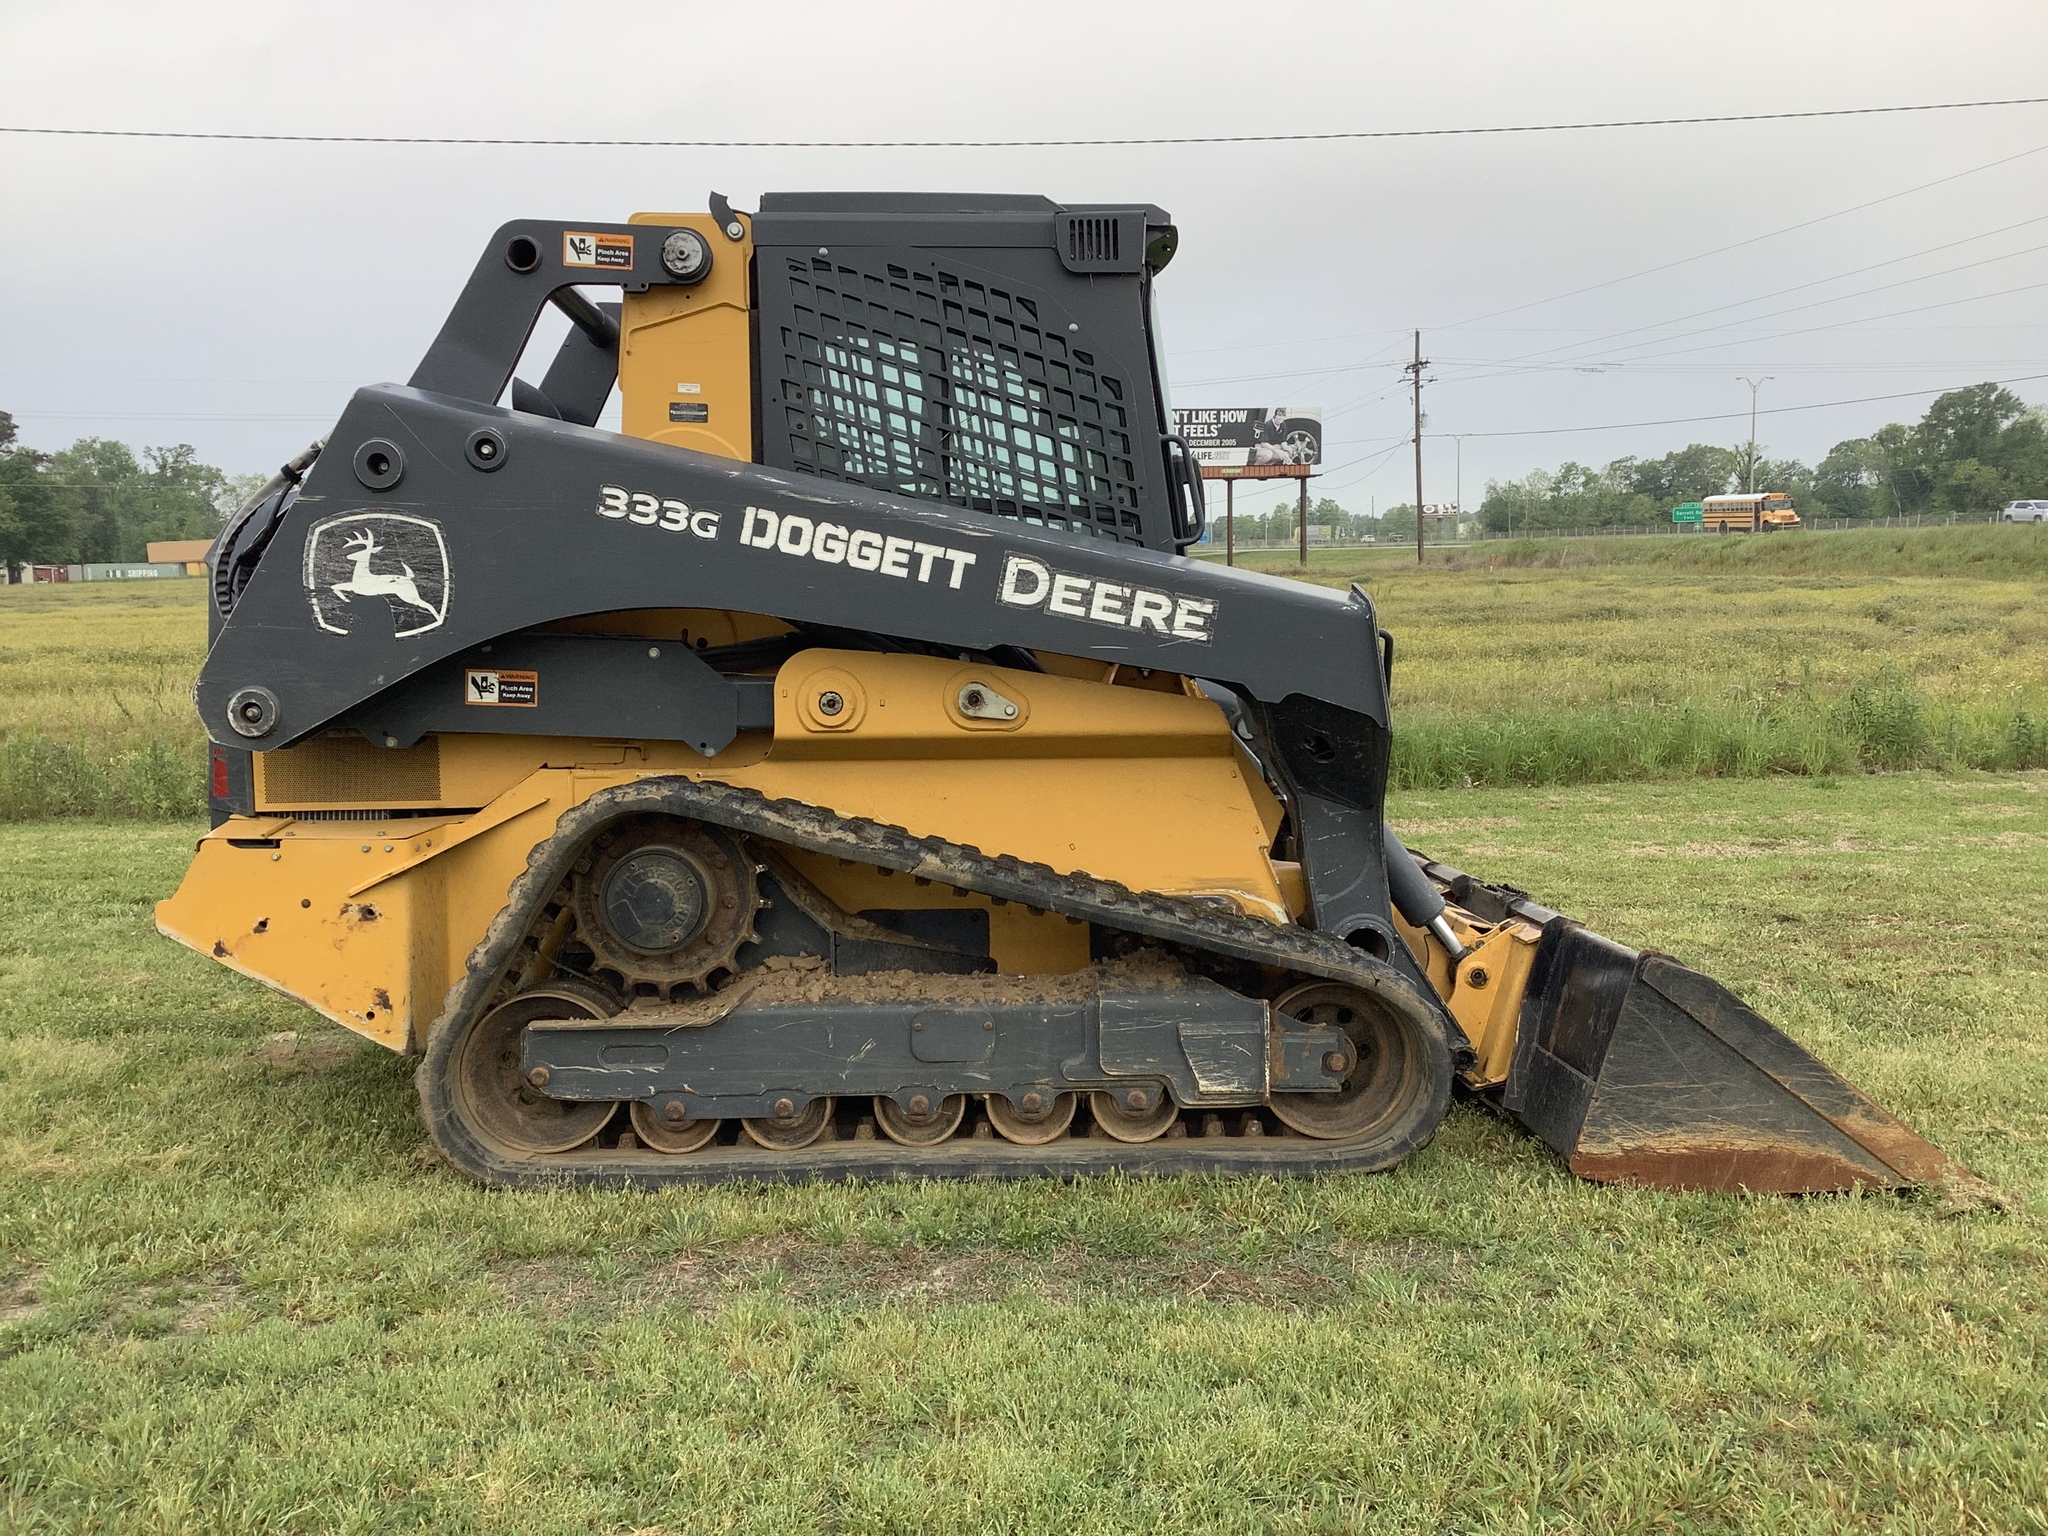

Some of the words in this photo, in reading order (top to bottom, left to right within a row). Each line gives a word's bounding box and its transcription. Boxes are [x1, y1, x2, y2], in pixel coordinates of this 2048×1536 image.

[1191, 410, 1217, 423] LIKE
[1220, 410, 1248, 423] HOW
[598, 486, 720, 539] 333G
[740, 506, 977, 589] DOGGETT
[1001, 555, 1214, 642] DEERE
[128, 569, 158, 577] SHIPPING
